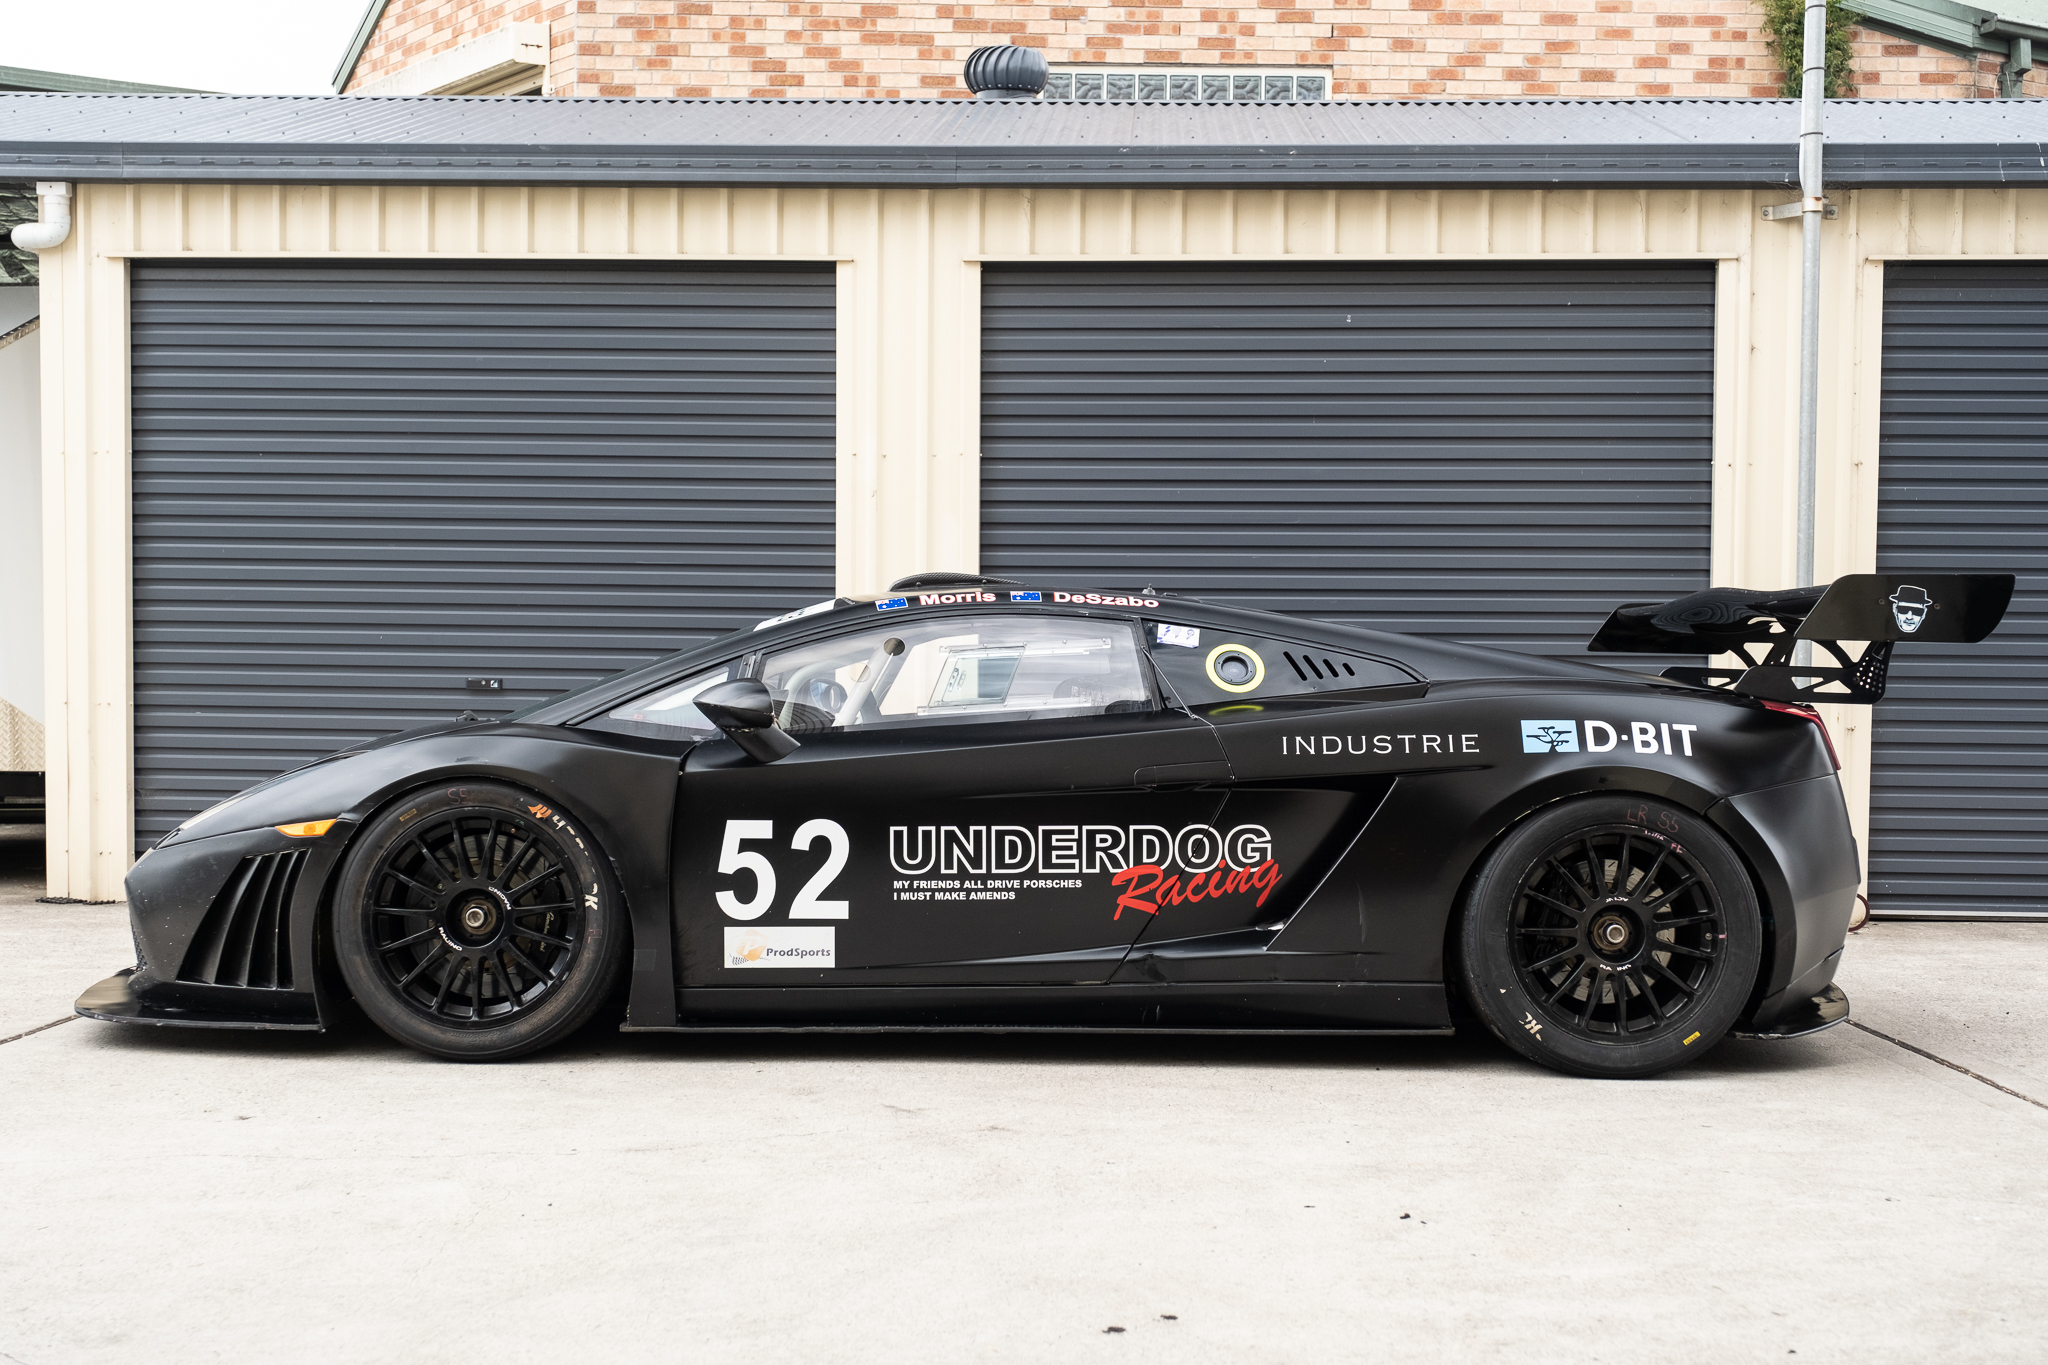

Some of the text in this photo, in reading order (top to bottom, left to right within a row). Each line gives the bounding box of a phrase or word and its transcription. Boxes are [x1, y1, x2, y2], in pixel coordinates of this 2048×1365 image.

[918, 591, 997, 606] Morris
[1053, 591, 1160, 608] DeSzabo
[1281, 733, 1481, 756] INDUSTRIE
[1626, 803, 1649, 825] LR
[889, 823, 1272, 875] UNDERDOG
[715, 818, 850, 921] 52
[893, 879, 1083, 889] MY FRIENDS ALL DRIVE PORSCHES
[1111, 858, 1283, 921] Racing
[893, 891, 1016, 901] I MUST MAKE AMENDS
[766, 947, 831, 959] ProdSports
